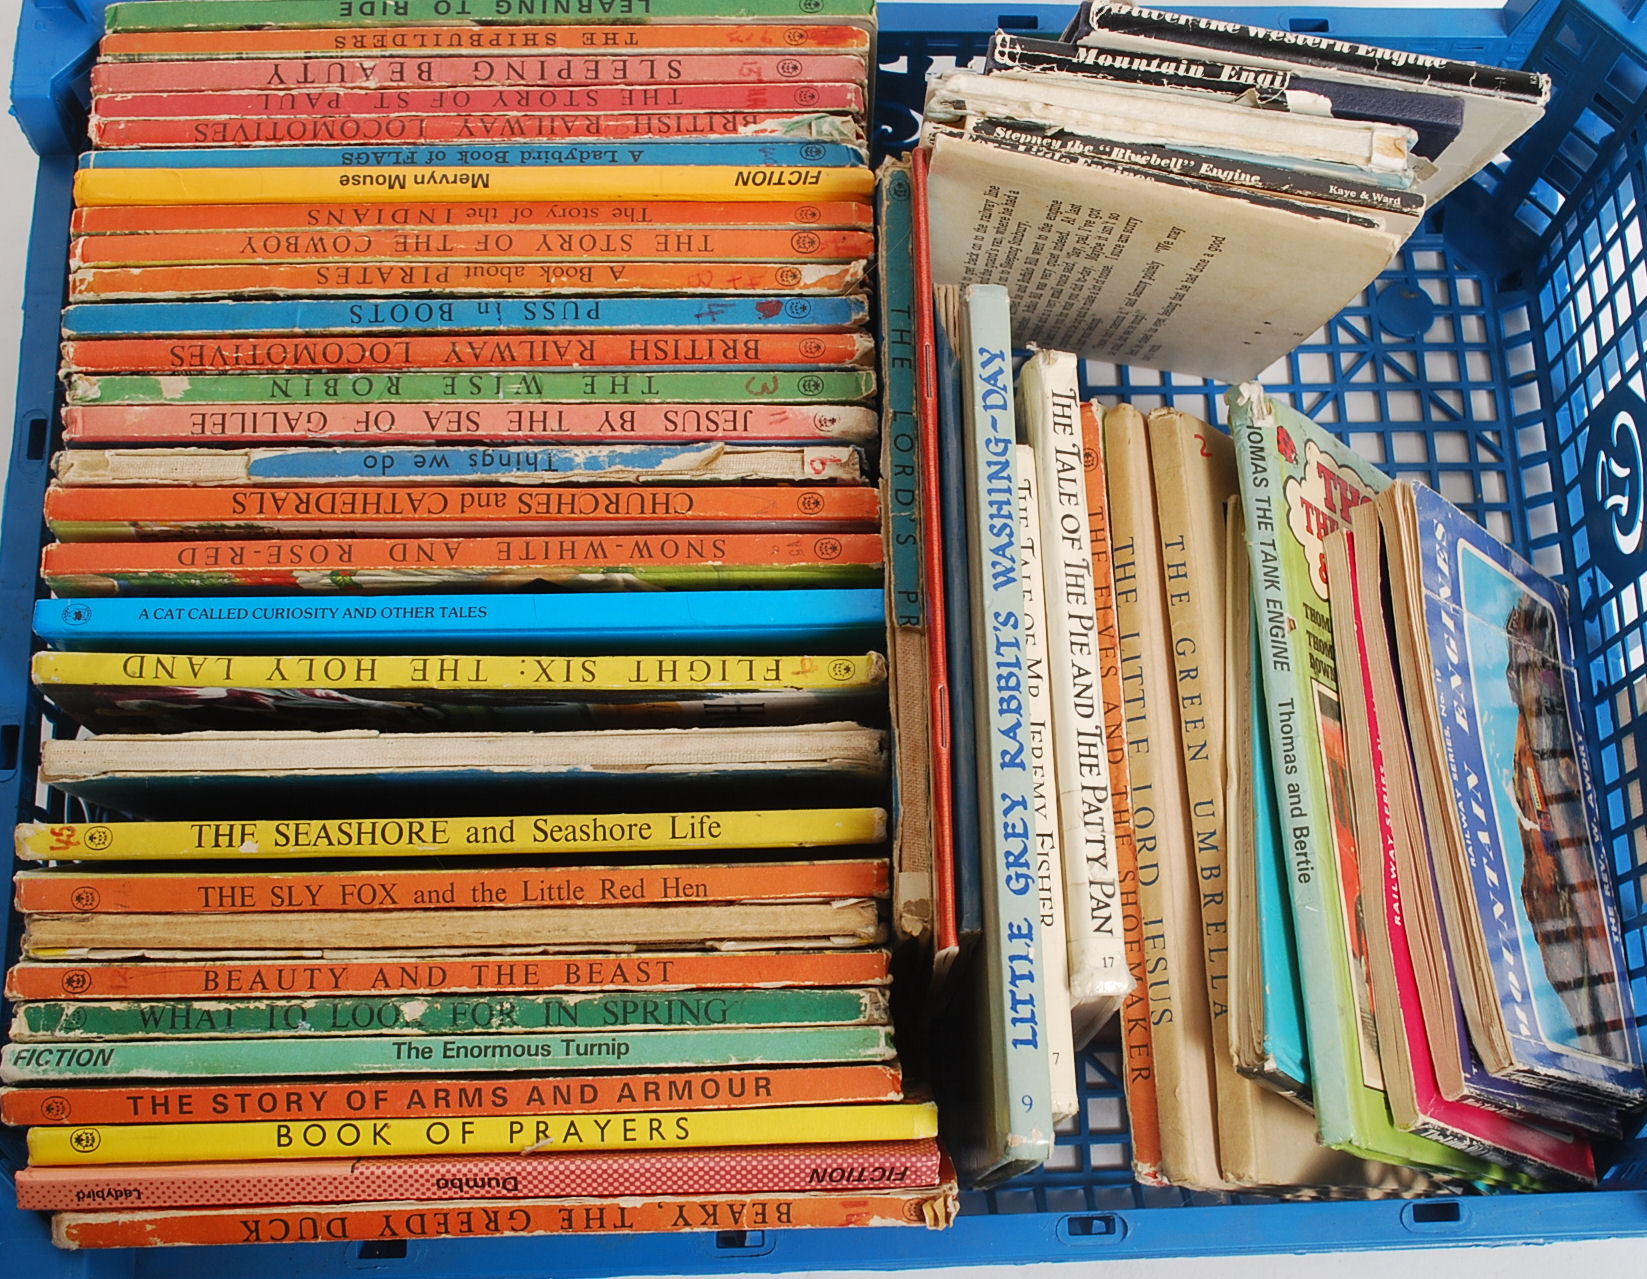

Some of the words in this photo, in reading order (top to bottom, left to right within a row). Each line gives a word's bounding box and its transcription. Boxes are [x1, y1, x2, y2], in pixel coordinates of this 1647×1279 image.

[267, 61, 432, 84] BEAUTY
[472, 59, 681, 80] SLEEPING
[1072, 47, 1205, 78] Mountain
[994, 127, 1061, 150] Stepney
[1066, 139, 1093, 153] the
[1200, 162, 1262, 186] Engine
[339, 174, 406, 190] Mouse
[414, 171, 490, 189] Mervyn
[735, 170, 822, 186] FICTION
[1329, 185, 1357, 198] Kaye
[1360, 191, 1368, 199] &
[1372, 192, 1401, 205] Ward
[307, 207, 452, 225] INDIANS
[465, 207, 498, 223] the
[509, 207, 533, 222] of
[547, 204, 599, 221] story
[611, 207, 652, 222] The
[629, 338, 760, 360] BRITISH
[891, 305, 912, 369] THE
[170, 341, 411, 367] LOCOMOTIVES
[444, 340, 594, 363] RAILWAY
[190, 411, 327, 434] GALILEE
[353, 411, 396, 433] OF
[423, 410, 480, 432] SEA
[507, 410, 569, 433] THE
[598, 410, 635, 432] BY
[664, 409, 754, 432] JESUS
[1051, 388, 1079, 436] THE
[363, 454, 394, 474] do
[413, 454, 449, 471] we
[468, 447, 558, 472] Things
[978, 347, 1018, 591] WASHING-DAY
[1054, 443, 1083, 506] TALE
[232, 491, 448, 515] CATHEDRALS
[459, 492, 506, 513] and
[517, 491, 694, 516] CHURCHES
[1255, 496, 1273, 531] THE
[1061, 513, 1083, 551] OF
[176, 543, 352, 567] ROSE-RED
[388, 541, 461, 563] AND
[496, 538, 725, 561] SNOW-WHITE
[1113, 536, 1138, 604] THE
[1164, 535, 1191, 608] THE
[1259, 539, 1281, 591] TANK
[1064, 559, 1092, 605] THE
[138, 607, 150, 620] A
[153, 608, 186, 620] CAT
[188, 607, 249, 620] CALLED
[252, 606, 339, 620] CURIOSITY
[342, 606, 377, 619] AND
[381, 605, 436, 619] OTHER
[439, 605, 488, 618] TALES
[1068, 613, 1095, 656] PIE
[1266, 598, 1290, 671] ENGINE
[1433, 519, 1470, 734] ENGINES
[122, 655, 232, 681] LAND
[266, 657, 376, 682] HOLY
[410, 658, 488, 681] THE
[519, 659, 597, 682] SIX:
[627, 658, 782, 682] FLIGHT
[1071, 659, 1098, 719] AND
[1173, 637, 1209, 763] GREEN
[1277, 698, 1299, 775] Thomas
[1077, 725, 1105, 777] THE
[1576, 730, 1595, 808] AWDRY
[1288, 782, 1304, 819] and
[191, 823, 258, 848] THE
[274, 819, 450, 846] SEASHORE
[466, 820, 515, 844] and
[532, 817, 653, 843] Seashore
[670, 814, 722, 841] Life
[1081, 784, 1111, 872] PATTY
[1131, 783, 1160, 887] LORD
[1455, 788, 1477, 867] RAILWAY
[1591, 817, 1600, 842] W.
[1001, 793, 1029, 896] GREY
[1292, 827, 1314, 884] Bertie
[1384, 835, 1402, 926] RAILWAY
[1599, 854, 1612, 896] REV.
[197, 885, 256, 908] THE
[271, 884, 324, 907] SLY
[340, 883, 399, 905] FOX
[413, 882, 455, 904] and
[472, 881, 507, 903] the
[522, 880, 585, 902] Little
[600, 877, 645, 900] Red
[663, 877, 708, 898] Hen
[1089, 879, 1116, 935] PAN
[1191, 798, 1229, 1020] UMBRELLA
[1608, 905, 1620, 944] THE
[1102, 956, 1115, 969] 17
[1143, 917, 1173, 1027] JESUS
[204, 967, 349, 992] BEAUTY
[372, 966, 447, 989] AND
[472, 963, 540, 986] THE
[566, 961, 675, 984] BEAST
[1007, 917, 1038, 1050] LITTLE
[13, 1048, 114, 1068] FICTION
[393, 1042, 433, 1061] The
[443, 1040, 551, 1059] Enormous
[560, 1037, 630, 1059] Turnip
[127, 1094, 195, 1117] THE
[211, 1091, 329, 1115] STORY
[345, 1090, 389, 1111] OF
[407, 1084, 509, 1110] ARMS
[526, 1083, 599, 1106] AND
[617, 1077, 774, 1103] ARMOUR
[1021, 1094, 1033, 1113] 9
[276, 1122, 393, 1148] BOOK
[425, 1121, 475, 1145] OF
[509, 1116, 690, 1144] PRAYERS
[435, 1176, 519, 1194] Dumbo
[808, 1166, 909, 1184] FICTION
[75, 1188, 142, 1202] Ladybird
[379, 1208, 531, 1241] GREEDY
[558, 1206, 633, 1231] THE
[657, 1201, 793, 1227] BEAKY,
[238, 1216, 348, 1243] DUCK
